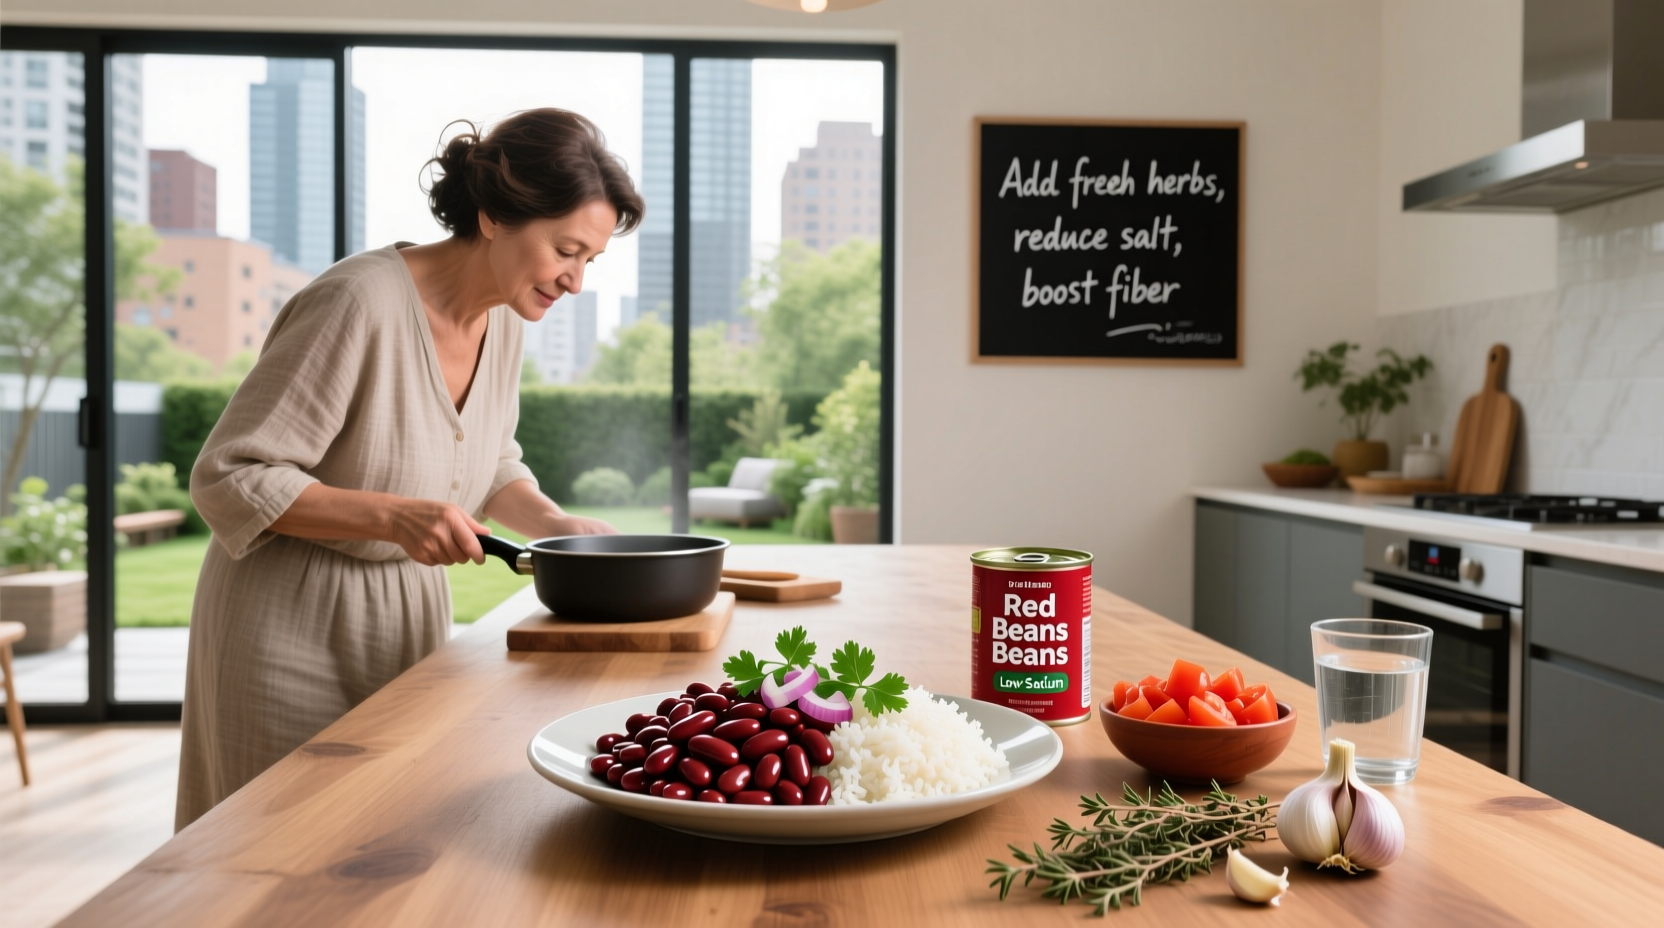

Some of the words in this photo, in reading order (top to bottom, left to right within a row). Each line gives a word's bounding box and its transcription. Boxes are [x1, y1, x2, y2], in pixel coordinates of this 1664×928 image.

[998, 157, 1060, 199] Add
[1147, 160, 1225, 203] herbs,
[1014, 215, 1108, 252] reduce
[1120, 214, 1182, 257] salt,
[1022, 267, 1099, 308] boost
[1106, 264, 1181, 319] fiber
[1004, 593, 1056, 618] Red
[992, 617, 1068, 642] Beans
[992, 641, 1068, 666] Beans
[1000, 676, 1023, 689] Low
